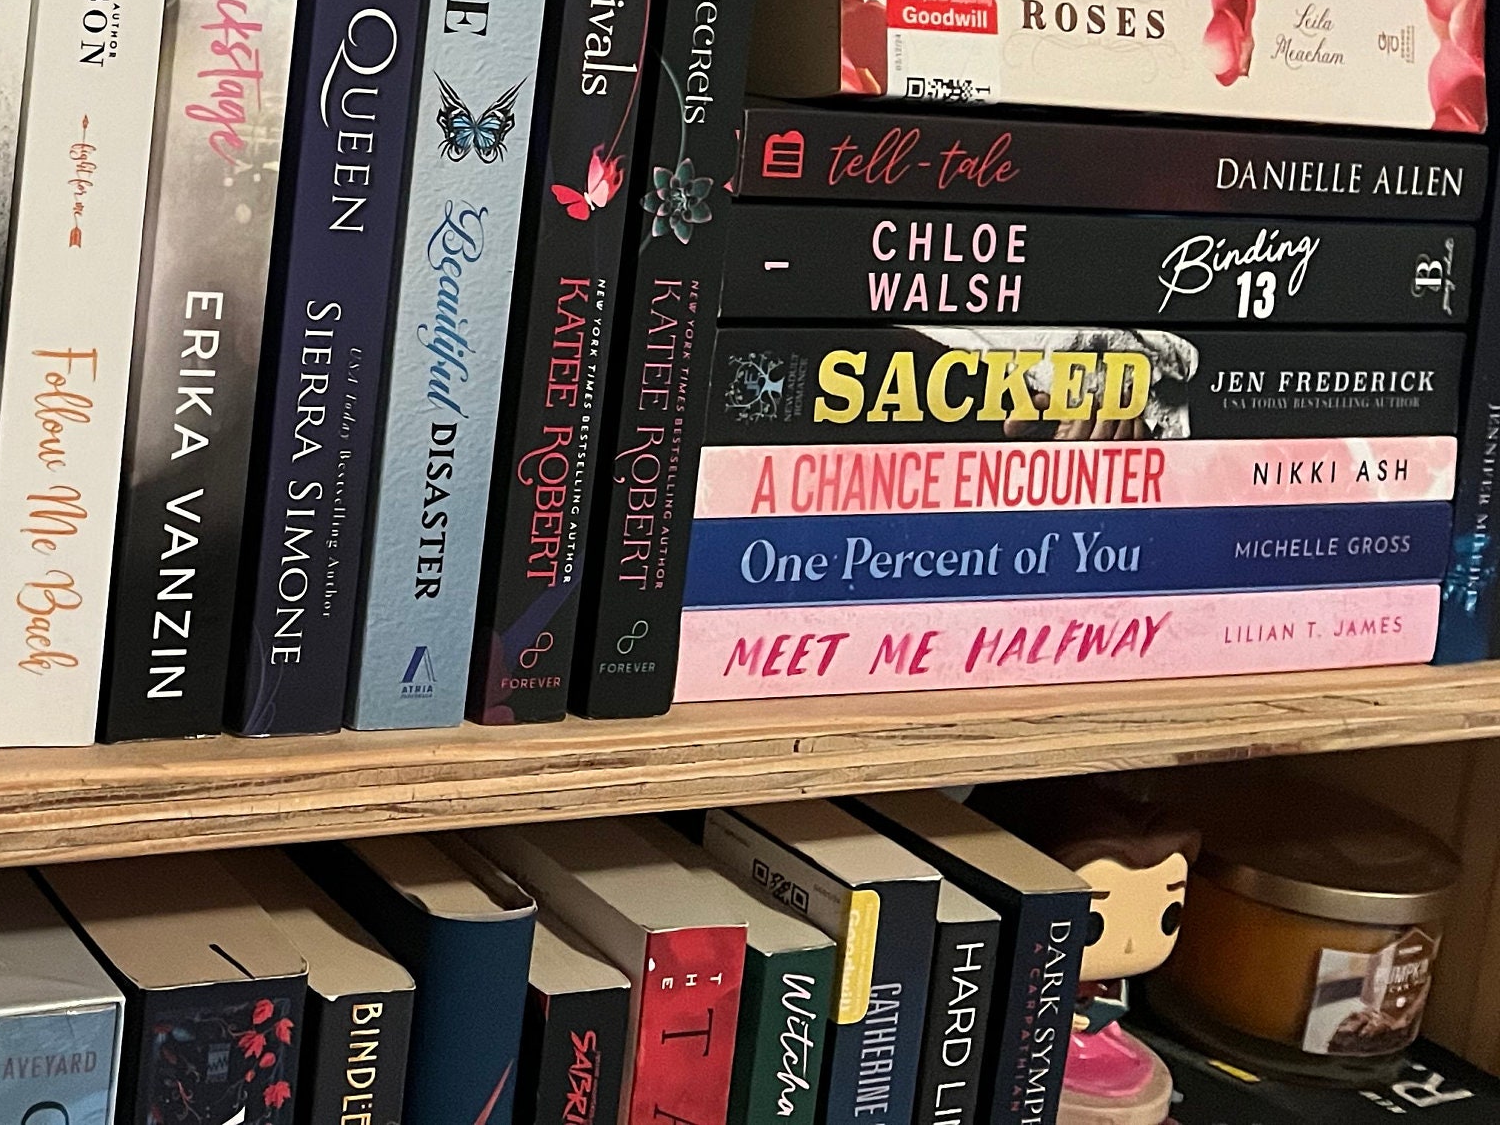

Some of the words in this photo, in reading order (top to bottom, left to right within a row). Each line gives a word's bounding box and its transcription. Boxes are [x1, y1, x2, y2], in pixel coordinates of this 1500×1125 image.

[108, 2, 120, 59] AUTHOR
[902, 6, 987, 28] Goodwill
[1271, 33, 1345, 70] Meacham
[1293, 2, 1334, 37] Leila
[320, 8, 398, 233] QUEEN
[828, 127, 1021, 190] tell-tale
[1216, 157, 1362, 194] DANIELLE
[1372, 166, 1464, 197] ALLEN
[872, 220, 1026, 263] CHLOE
[1158, 228, 1320, 314] Binding
[417, 199, 489, 419] Beautiful
[596, 278, 606, 310] NEW
[688, 280, 699, 311] NEW
[868, 272, 1022, 313] WALSH
[1236, 271, 1276, 319] 13
[545, 277, 591, 408] KATEE
[589, 318, 602, 356] YORK
[639, 278, 682, 411] KATEE
[682, 320, 695, 358] YORK
[31, 347, 98, 473] Follow
[170, 291, 224, 460] ERIKA
[291, 300, 343, 464] SIERRA
[583, 365, 595, 408] TIMES
[675, 367, 689, 412] TIMES
[813, 349, 1152, 424] SACKED
[1210, 371, 1266, 394] JEN
[1277, 371, 1435, 393] FREDERICK
[325, 449, 353, 549] Bestselling
[570, 415, 590, 514] BESTSELLING
[663, 418, 683, 520] BESTSELLING
[750, 455, 777, 515] A
[791, 450, 946, 513] CHANCE
[953, 447, 1167, 510] ENCOUNTER
[1253, 461, 1336, 486] NIKKI
[1356, 458, 1409, 483] ASH
[19, 485, 88, 556] Me
[414, 422, 458, 601] DISASTER
[517, 426, 573, 587] ROBERT
[613, 426, 665, 591] ROBERT
[270, 480, 324, 665] SIMONE
[563, 522, 576, 583] AUTHOR
[654, 526, 668, 589] AUTHOR
[741, 538, 829, 585] One
[841, 537, 1002, 581] Percent
[1014, 532, 1059, 576] of
[1072, 531, 1143, 574] You
[1234, 537, 1339, 559] MICHELLE
[1348, 535, 1411, 555] GROSS
[16, 569, 83, 676] Back
[147, 488, 205, 700] VANZIN
[321, 557, 340, 620] Author
[600, 662, 656, 673] FOREVER
[723, 632, 850, 677] MEET
[869, 630, 940, 675] ME
[964, 611, 1173, 674] HALFWAY
[1223, 623, 1295, 644] LILIAN
[1333, 616, 1403, 637] JAMES
[501, 677, 561, 689] FOREVER
[942, 942, 984, 1067] HARD
[1038, 921, 1071, 1018] DARK
[1, 1050, 97, 1081] AVEYARD
[777, 973, 815, 1117] Witcha
[854, 982, 901, 1118] CATHERINE
[1011, 968, 1041, 1111] CARPATHIAN
